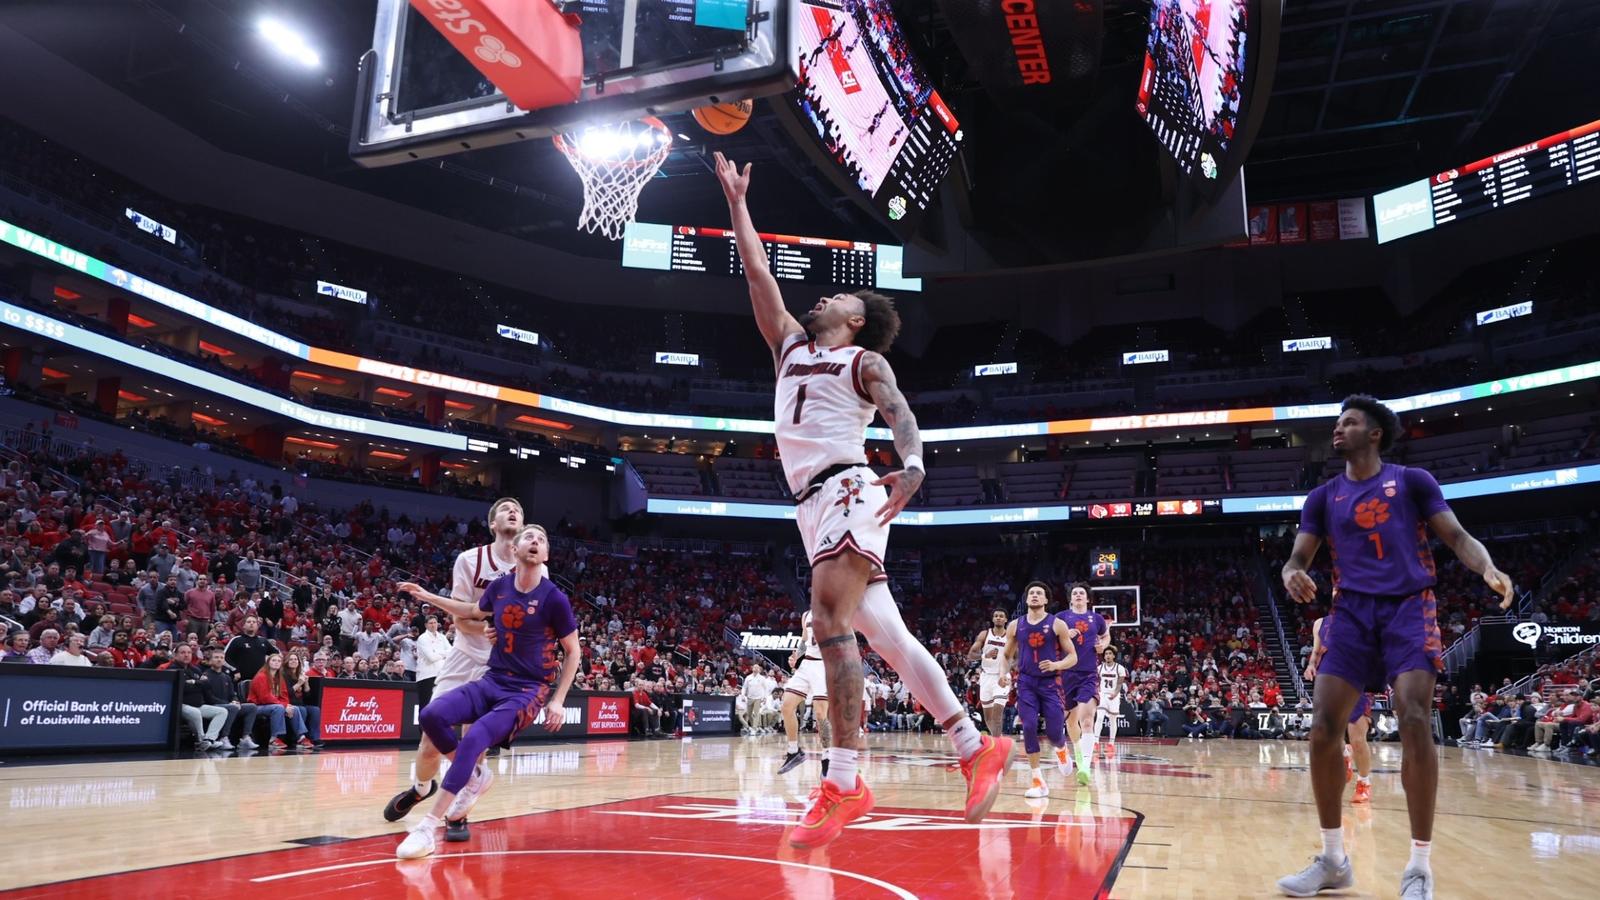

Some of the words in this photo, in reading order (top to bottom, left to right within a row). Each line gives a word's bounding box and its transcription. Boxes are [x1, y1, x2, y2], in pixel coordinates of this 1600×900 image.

[1002, 0, 1051, 85] CENTER
[1493, 143, 1538, 163] LOUISVILLE
[16, 230, 88, 272] VALUE
[4, 308, 21, 323] to
[25, 314, 65, 338] $$$$
[210, 307, 300, 356] PROTECTION
[1299, 339, 1327, 350] BAIRD
[670, 355, 695, 363] BAIRD
[783, 361, 847, 380] LOUISVILLE
[417, 370, 500, 398] CARWASH
[793, 384, 807, 425] 1
[296, 406, 319, 424] Easy
[320, 412, 334, 424] to
[1145, 410, 1229, 427] CARWASH
[1530, 480, 1541, 488] for
[1542, 478, 1556, 486] the
[678, 505, 691, 513] Look
[1113, 504, 1126, 514] 30
[1135, 504, 1153, 512] 2:48
[1367, 533, 1383, 559] 1
[1099, 553, 1116, 562] 2:48
[504, 633, 514, 653] 3
[1104, 679, 1113, 689] 24
[23, 700, 68, 712] Official
[70, 701, 99, 712] Bank
[101, 702, 113, 712] of
[115, 702, 166, 715] University
[345, 696, 358, 707] Be
[360, 696, 379, 711] safe,
[20, 715, 34, 725] of
[36, 715, 91, 725] Louisville
[92, 715, 141, 725] Athletics
[339, 709, 383, 723] Kentucky.
[598, 711, 619, 721] Kentucky.
[324, 724, 344, 733] VISIT
[345, 724, 395, 734] BUPDKY.COM
